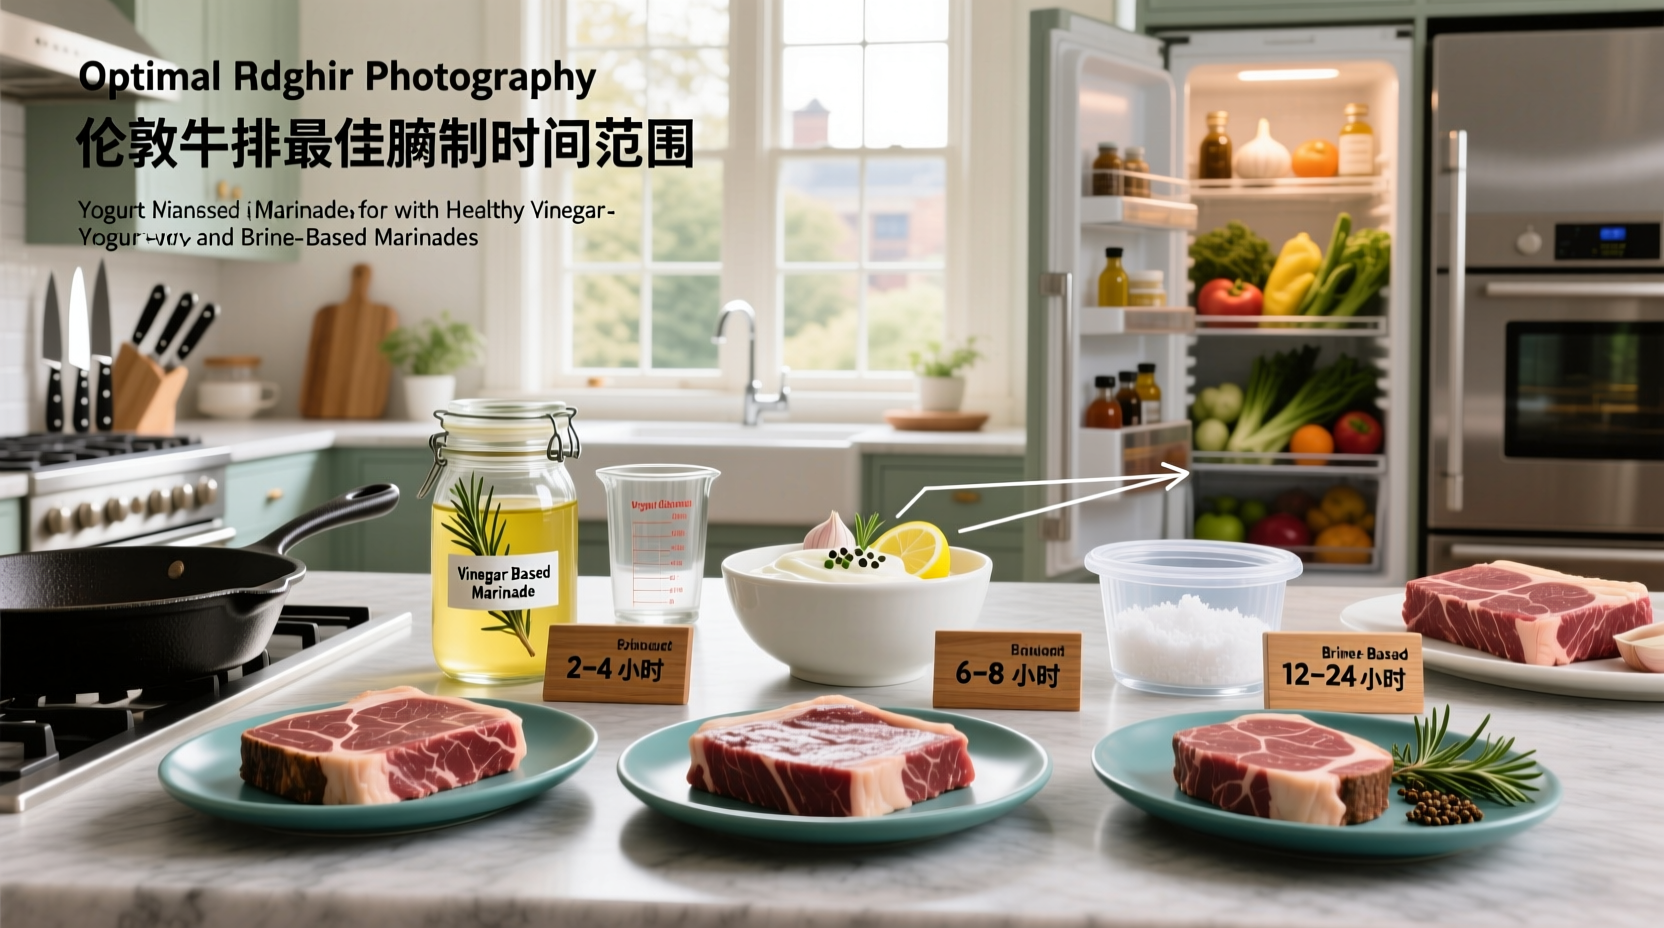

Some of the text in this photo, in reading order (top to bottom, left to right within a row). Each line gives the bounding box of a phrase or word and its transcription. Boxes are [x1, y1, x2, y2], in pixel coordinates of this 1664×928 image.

[457, 564, 551, 586] Vinegar Based
[471, 584, 536, 600] Marinade
[566, 655, 665, 683] 2-4 小时
[955, 660, 1061, 689] 6-8 小时
[1282, 662, 1406, 692] 12-24 小时
